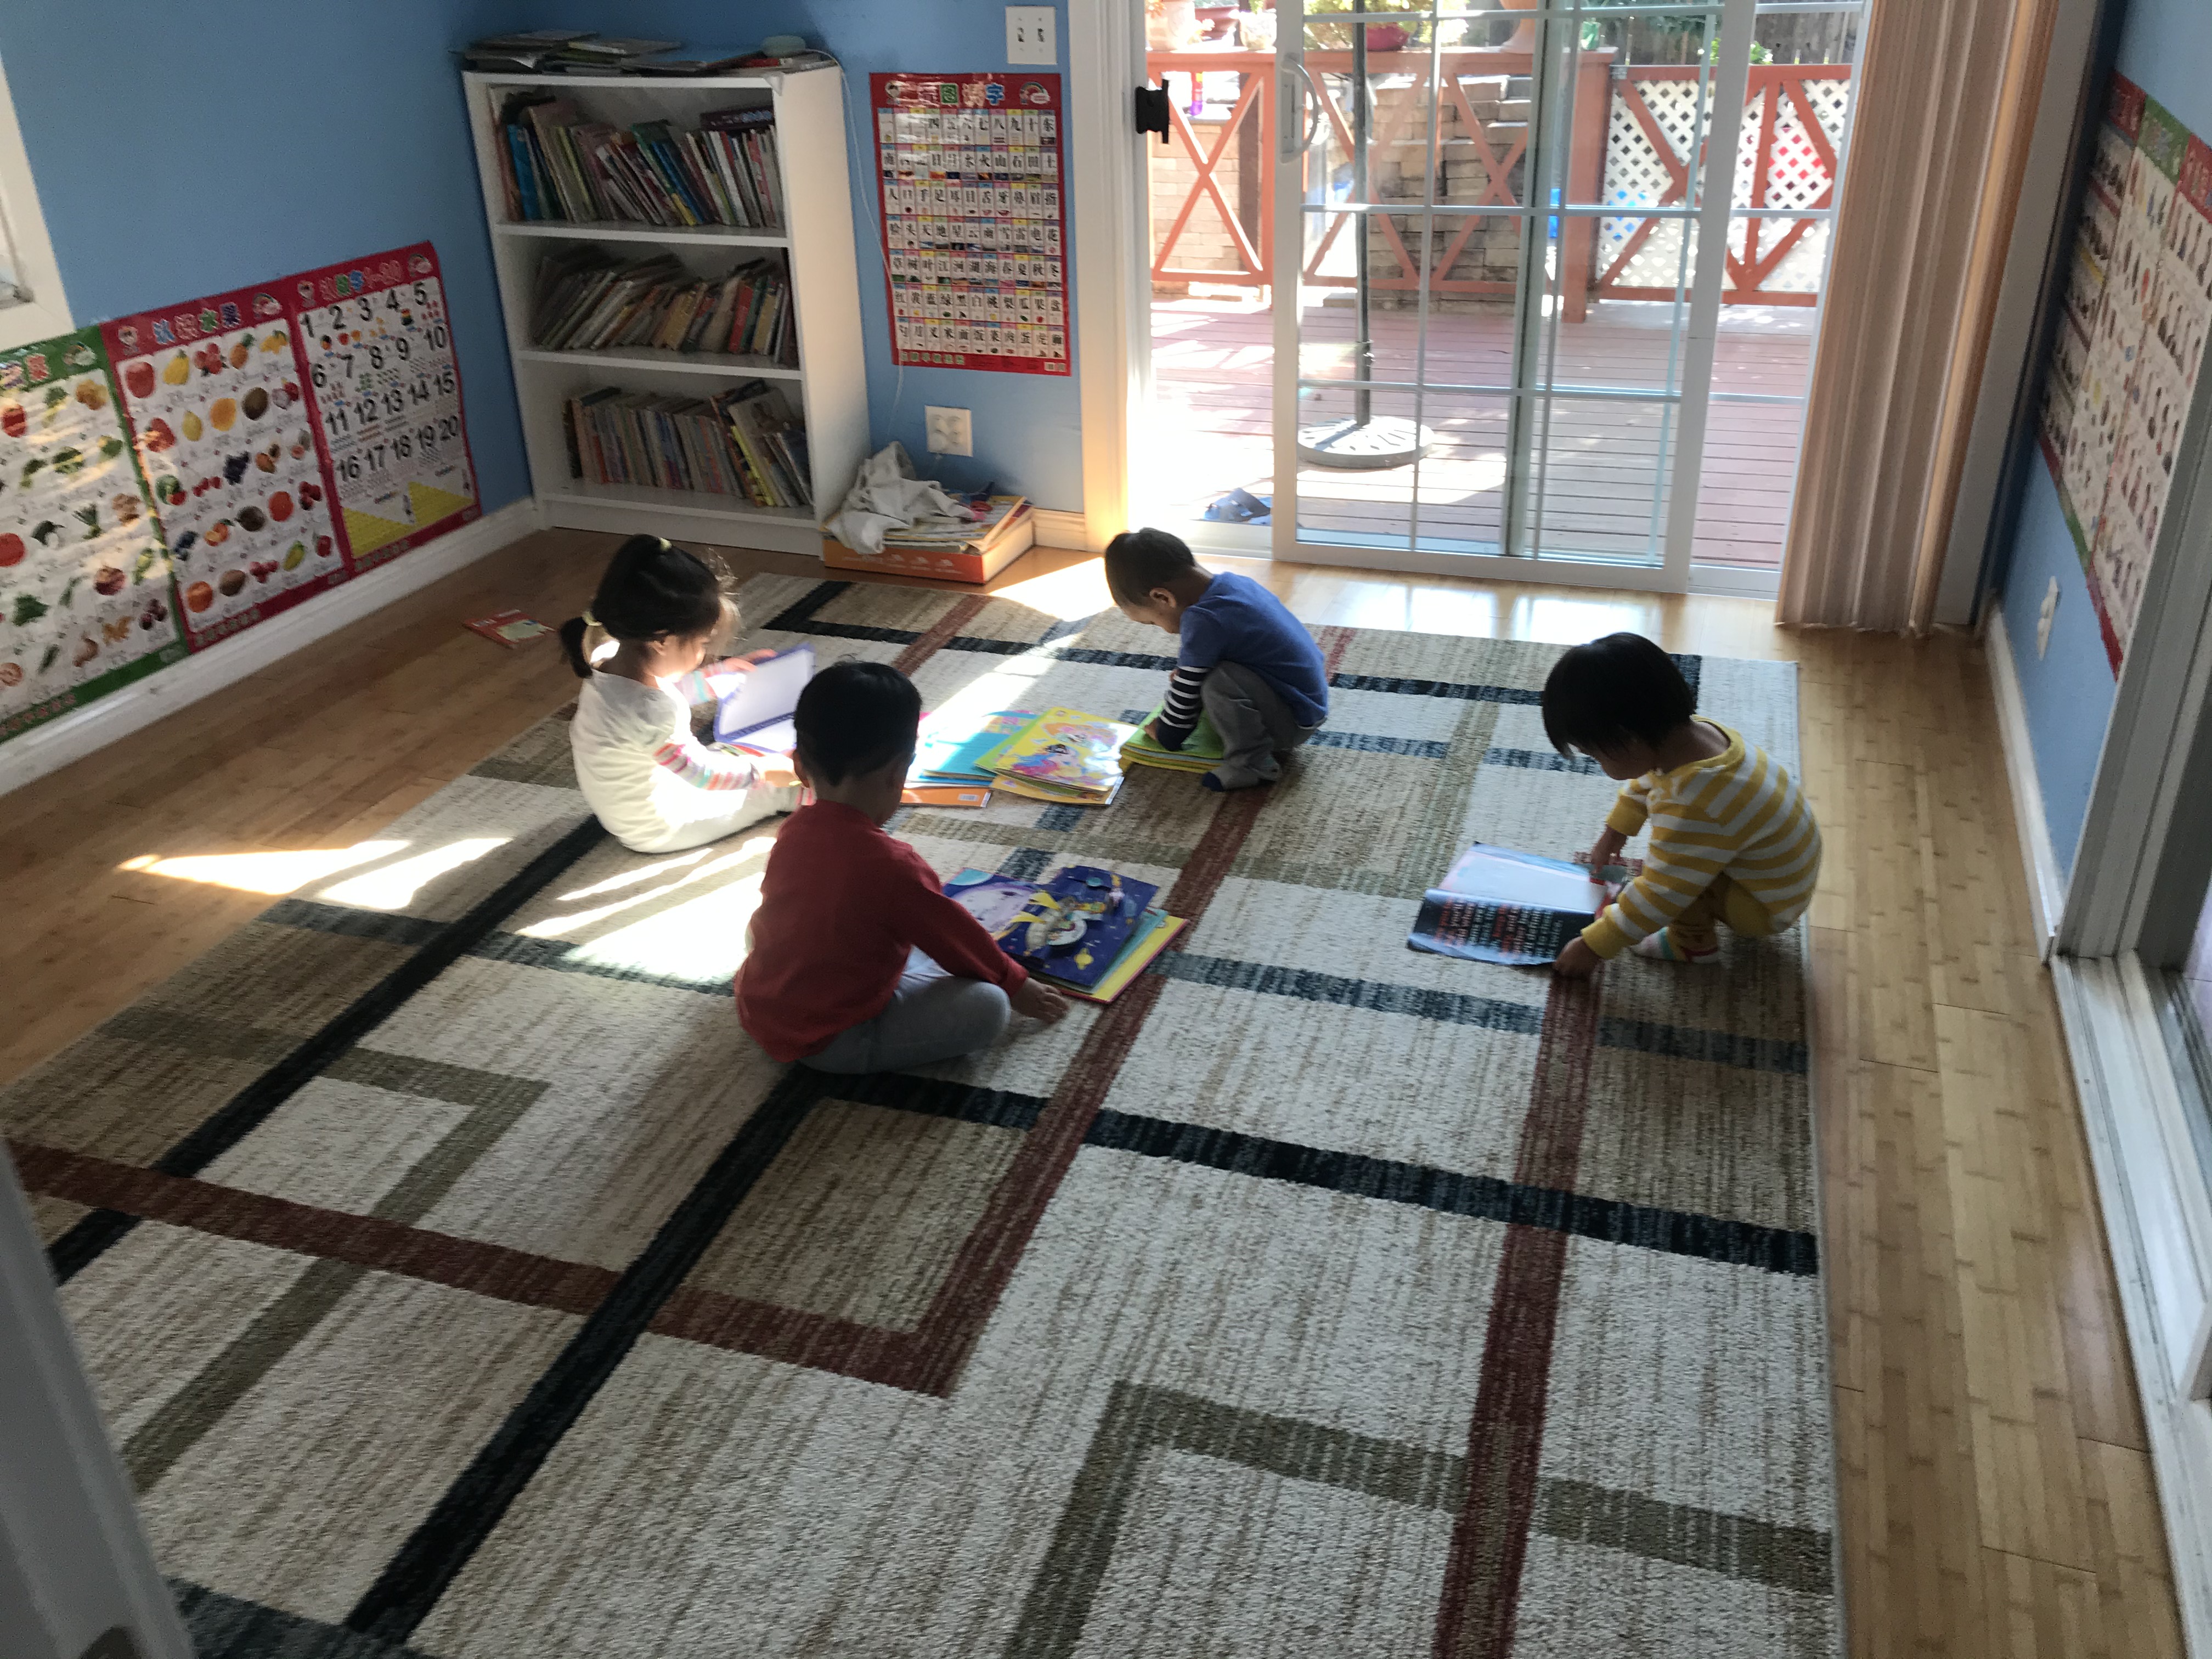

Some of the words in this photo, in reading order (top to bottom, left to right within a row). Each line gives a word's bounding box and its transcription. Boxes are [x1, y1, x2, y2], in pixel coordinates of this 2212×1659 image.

[300, 313, 314, 338] 1
[330, 306, 346, 330] 2
[357, 297, 373, 321] 3
[386, 290, 400, 310] 4
[413, 283, 427, 304] 5
[312, 364, 326, 387] 6
[341, 354, 354, 379] 7
[369, 346, 385, 369] 8
[396, 338, 411, 360] 9
[424, 327, 447, 351] 10
[326, 408, 349, 435] 11
[354, 400, 378, 424] 12
[382, 390, 403, 413] 13
[408, 381, 430, 404] 14
[434, 373, 455, 397] 15
[337, 455, 362, 481] 16
[364, 447, 386, 470] 17
[390, 436, 412, 459] 18
[415, 425, 436, 450] 19
[439, 415, 460, 441] 20
